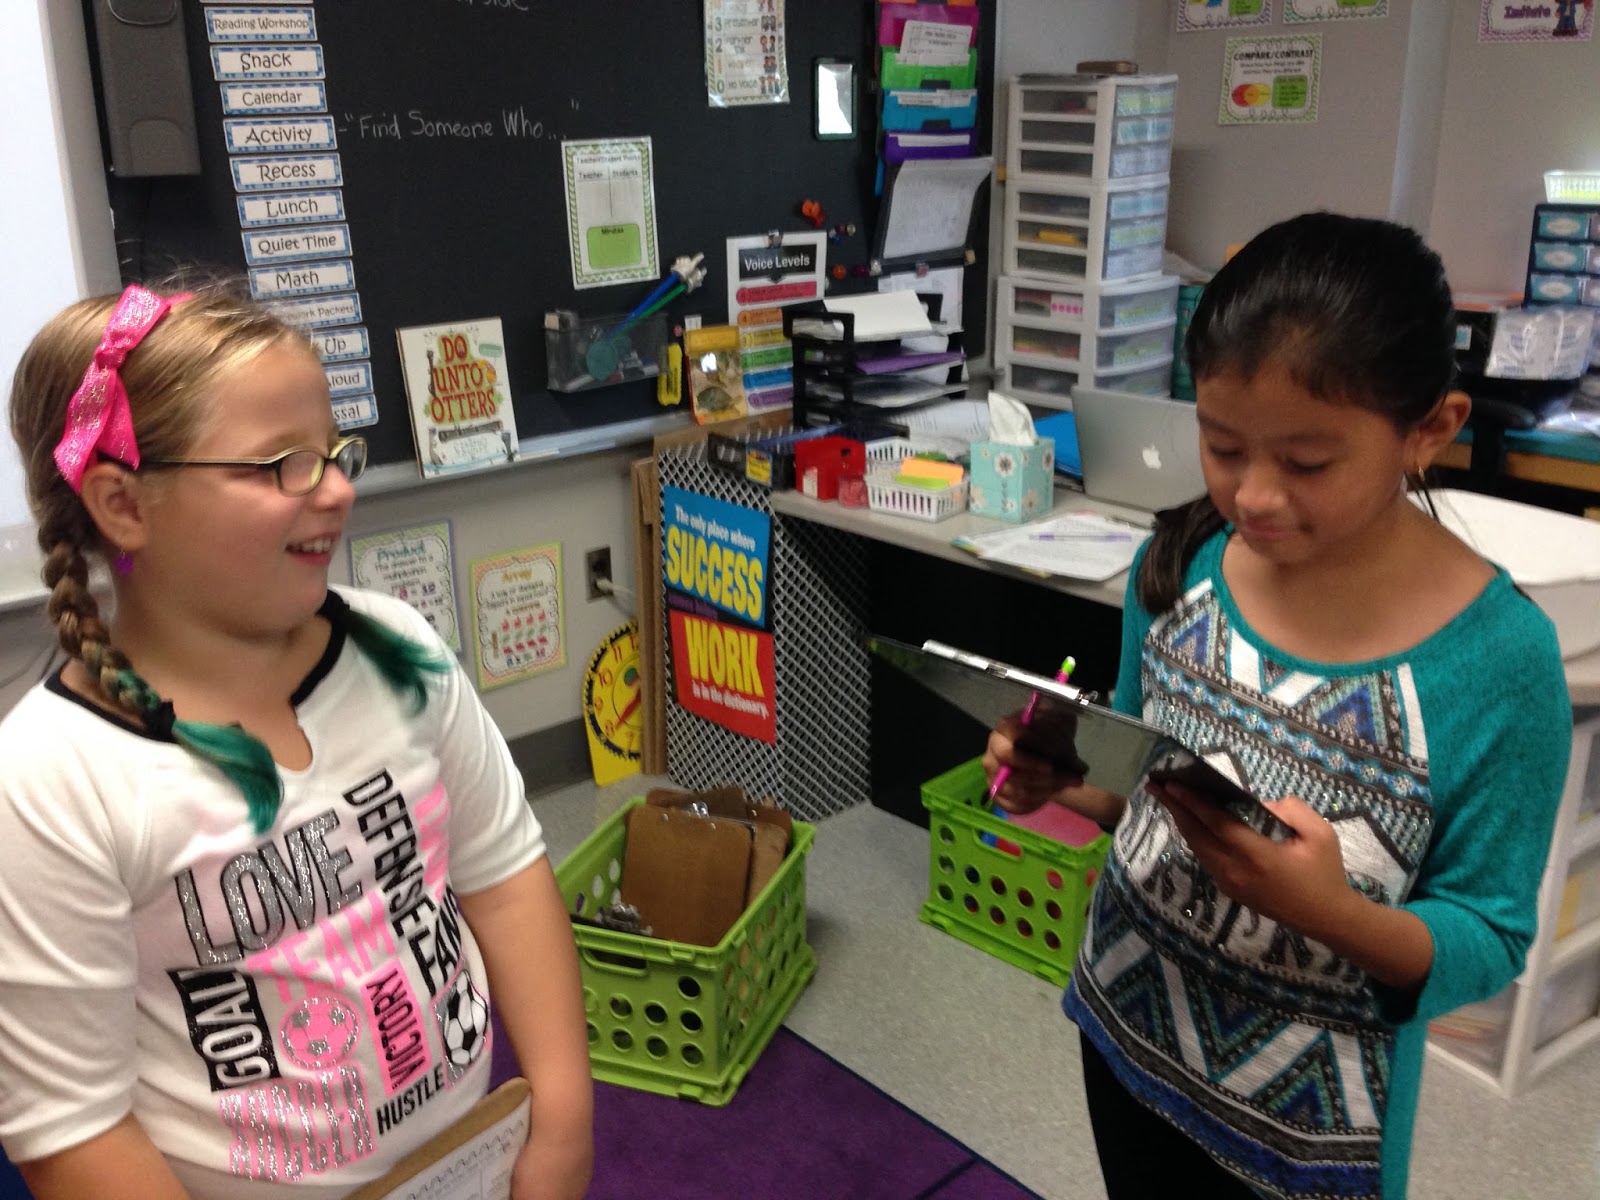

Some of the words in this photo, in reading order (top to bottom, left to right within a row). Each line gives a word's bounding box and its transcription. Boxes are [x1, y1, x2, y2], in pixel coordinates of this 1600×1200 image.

[213, 18, 256, 30] Reading
[258, 17, 310, 30] Workshop
[715, 16, 722, 32] 3
[715, 38, 722, 53] 2
[239, 52, 293, 73] Snack
[242, 90, 304, 107] Calendar
[408, 110, 494, 138] Someone
[244, 126, 313, 146] Activity
[256, 163, 317, 182] Recess
[266, 197, 319, 219] Lunch
[257, 237, 300, 255] Quiet
[302, 234, 337, 250] Time
[744, 258, 773, 271] Voice
[775, 254, 811, 269] Levels
[275, 270, 320, 290] Math
[317, 305, 355, 318] Packets
[325, 337, 347, 355] Up
[441, 335, 468, 363] DO
[433, 362, 485, 394] UNTO
[334, 404, 361, 422] ssal
[430, 387, 497, 424] OTTERS
[674, 503, 689, 526] The
[689, 513, 707, 537] only
[706, 519, 730, 542] place
[729, 528, 756, 552] where
[666, 524, 764, 622] SUCCESS
[684, 615, 766, 698] WORK
[597, 668, 613, 688] 10
[691, 680, 701, 699] is
[700, 682, 711, 701] in
[709, 685, 724, 705] the
[342, 767, 437, 939] DEFENSE
[174, 807, 364, 967] LOVE
[245, 889, 397, 1004] TEAM
[177, 970, 271, 1087] GOAL
[366, 968, 426, 1089] VICTORY
[376, 1061, 446, 1136] HUSTLE
